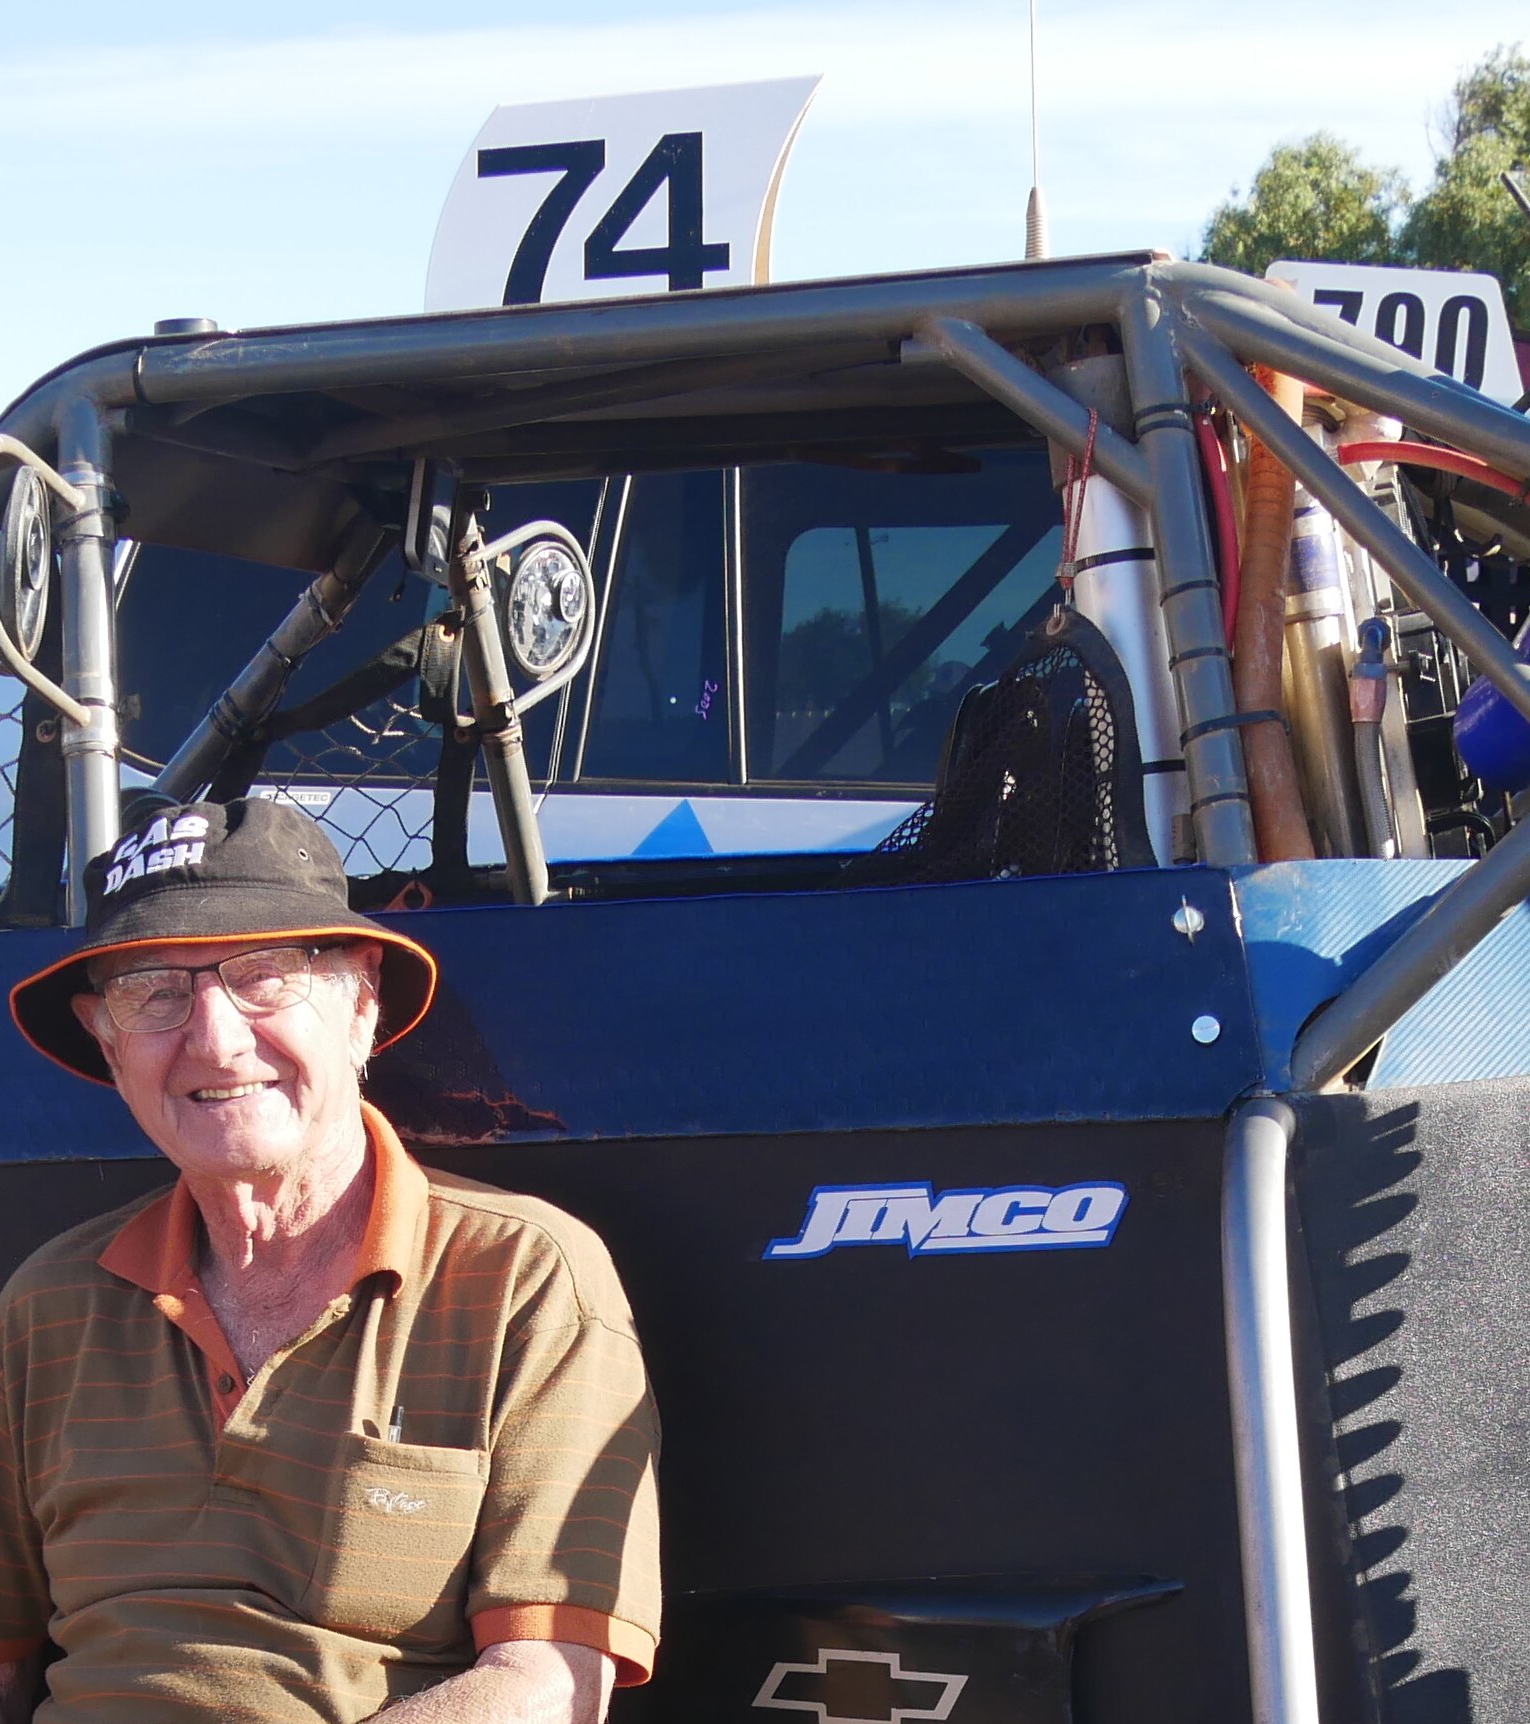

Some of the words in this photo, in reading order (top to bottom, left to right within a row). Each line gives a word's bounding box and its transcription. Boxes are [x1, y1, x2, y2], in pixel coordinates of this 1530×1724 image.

[478, 131, 730, 306] 74
[1313, 289, 1489, 392] 790
[103, 842, 206, 895] DASH
[114, 817, 209, 862] GAS
[763, 1182, 1128, 1258] JIMCO
